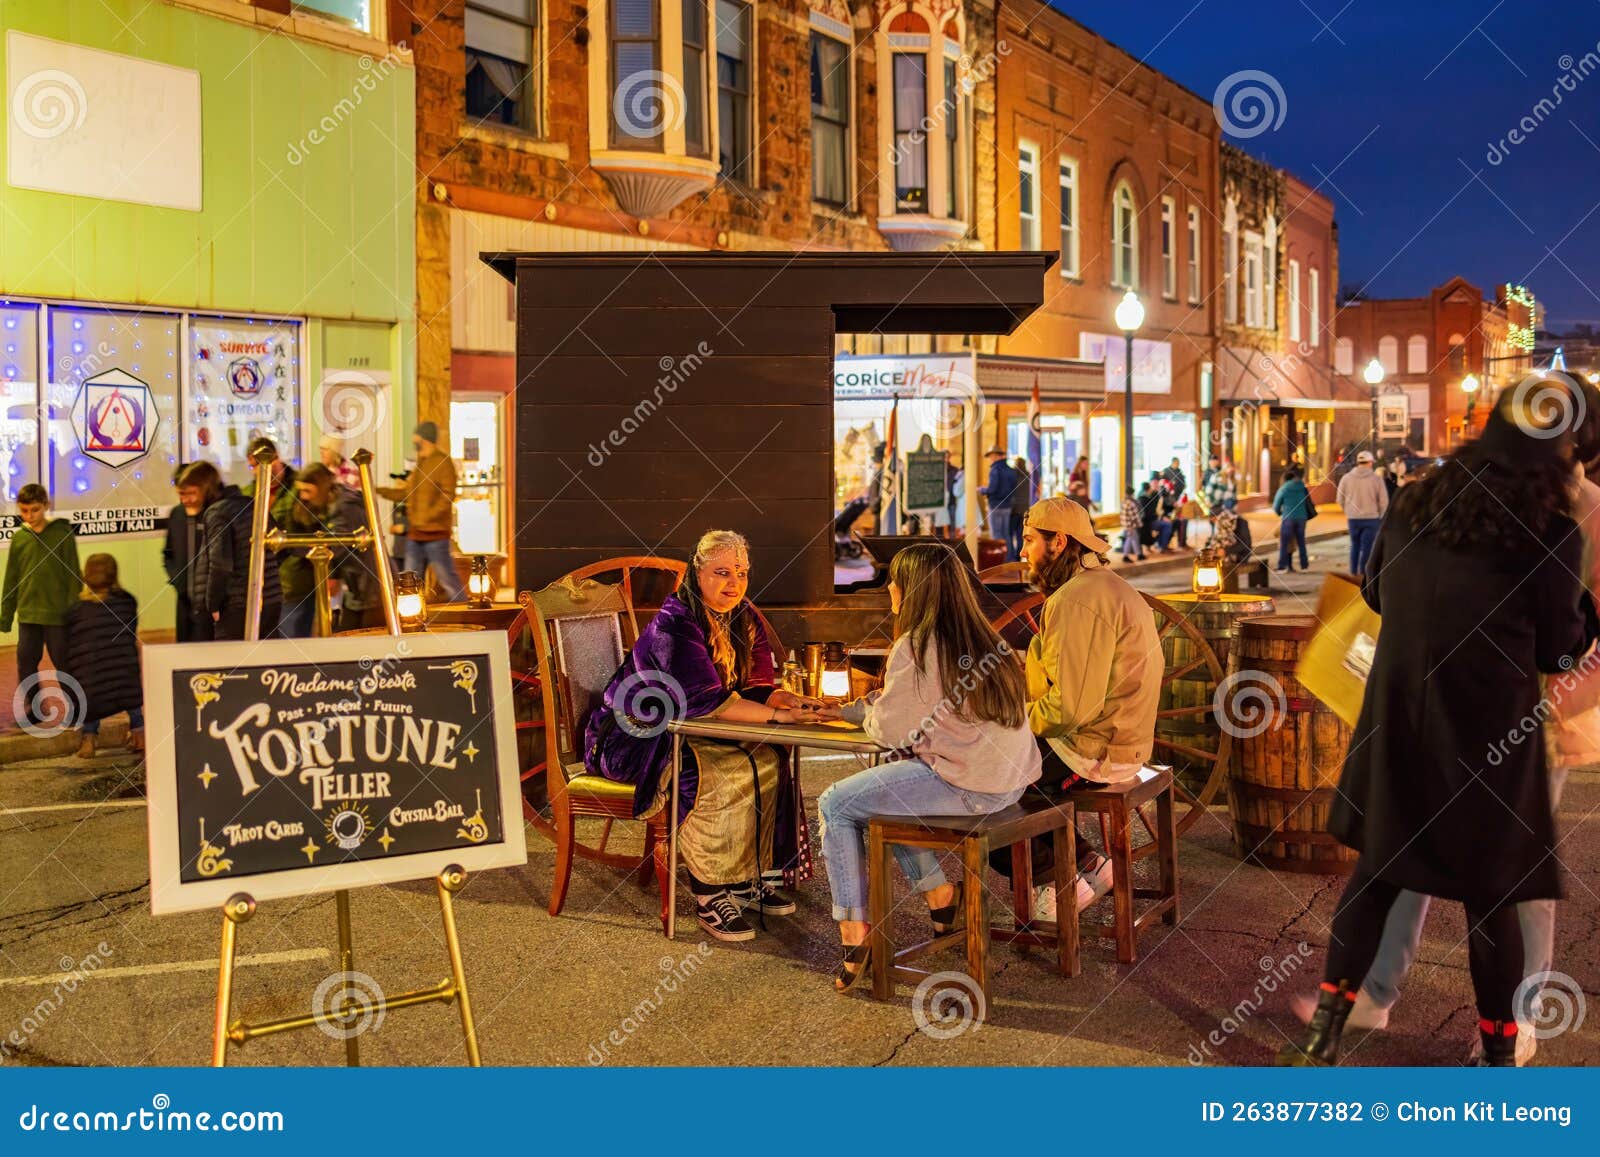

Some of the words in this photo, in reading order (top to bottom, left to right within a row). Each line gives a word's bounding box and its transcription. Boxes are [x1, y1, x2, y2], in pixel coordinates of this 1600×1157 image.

[73, 511, 102, 521] SELF
[106, 508, 160, 519] DEFENSE
[79, 522, 118, 535] ARNIS
[127, 519, 155, 531] KALI
[261, 669, 354, 698] Madame
[277, 708, 304, 723] Past
[315, 700, 362, 715] Present
[373, 700, 413, 714] Future
[208, 702, 462, 797] FORTUNE
[299, 766, 392, 810] TELLER
[389, 806, 435, 827] CRYSTAL
[434, 800, 464, 822] BALL
[223, 824, 263, 846] TAROT
[265, 820, 304, 841] CARDS
